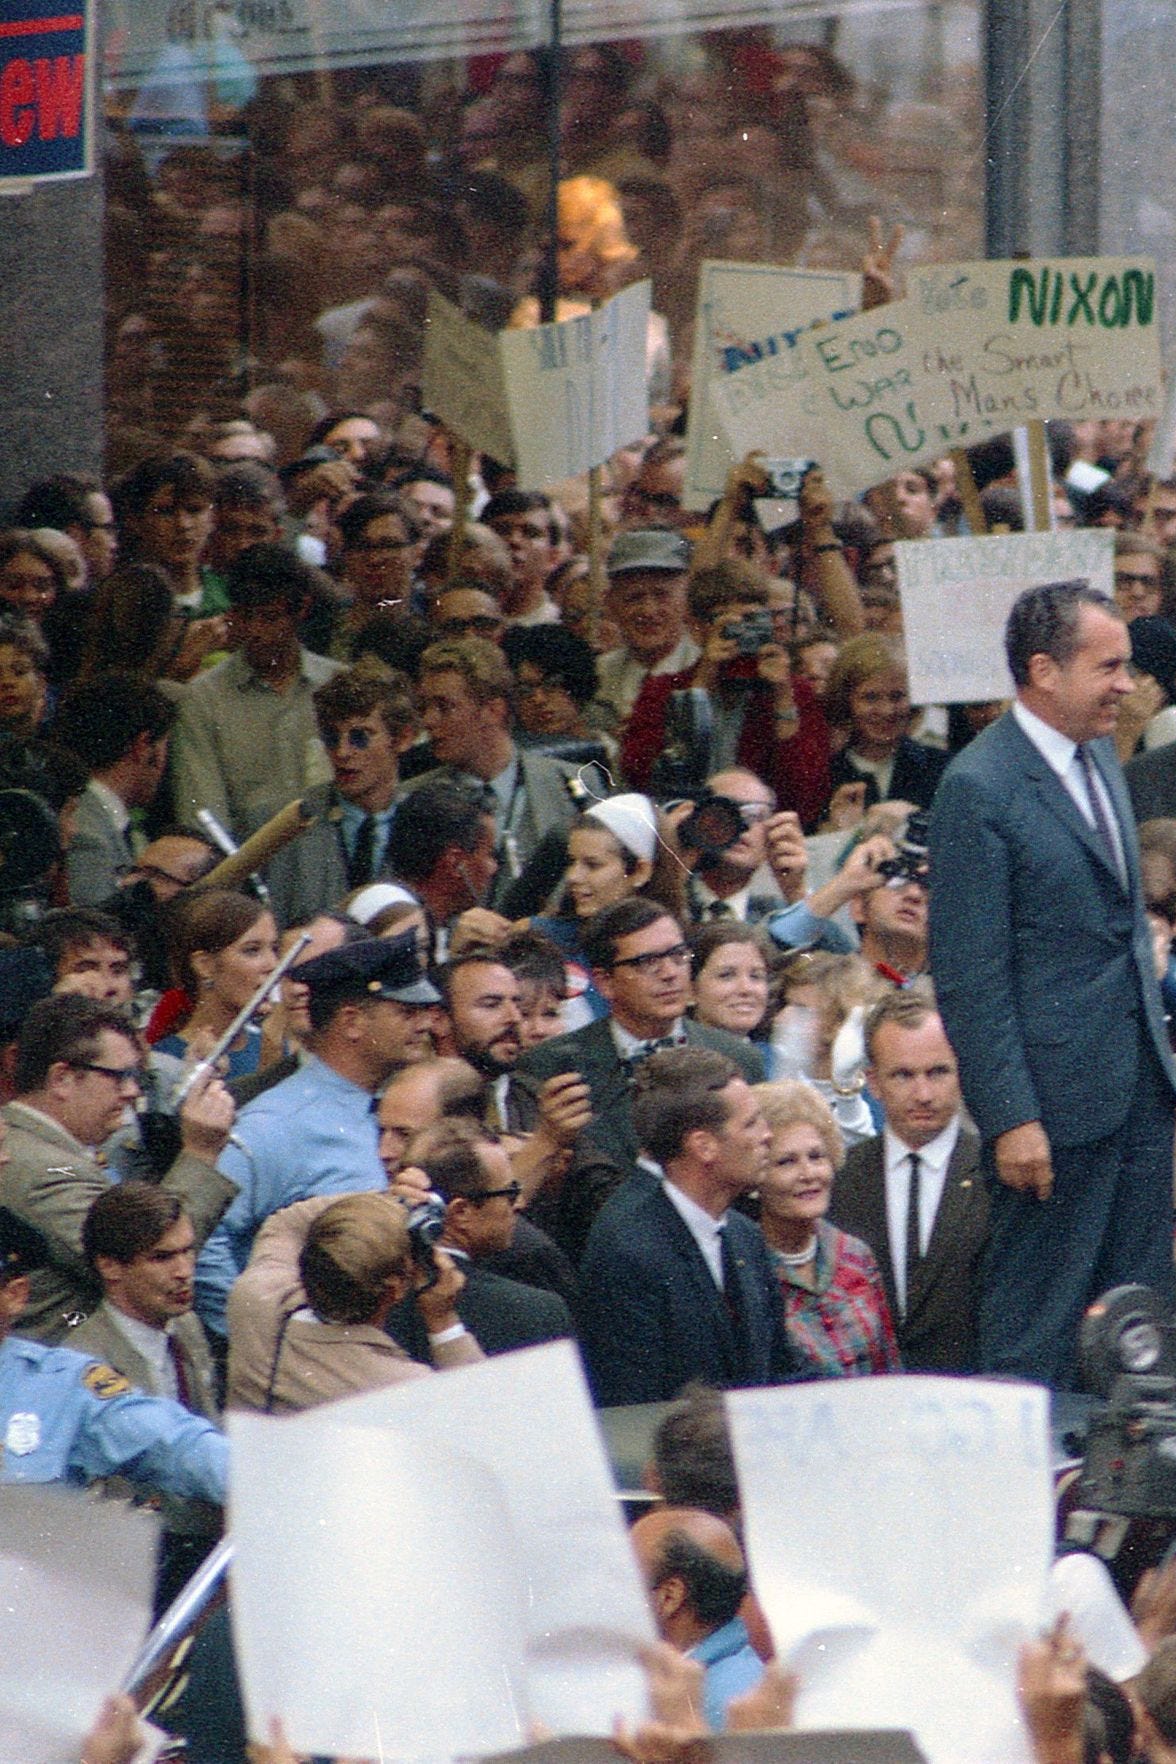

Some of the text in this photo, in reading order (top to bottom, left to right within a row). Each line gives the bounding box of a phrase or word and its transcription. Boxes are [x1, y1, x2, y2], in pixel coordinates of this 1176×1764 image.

[1006, 265, 1156, 330] NIXON
[922, 333, 1091, 376] the Smart
